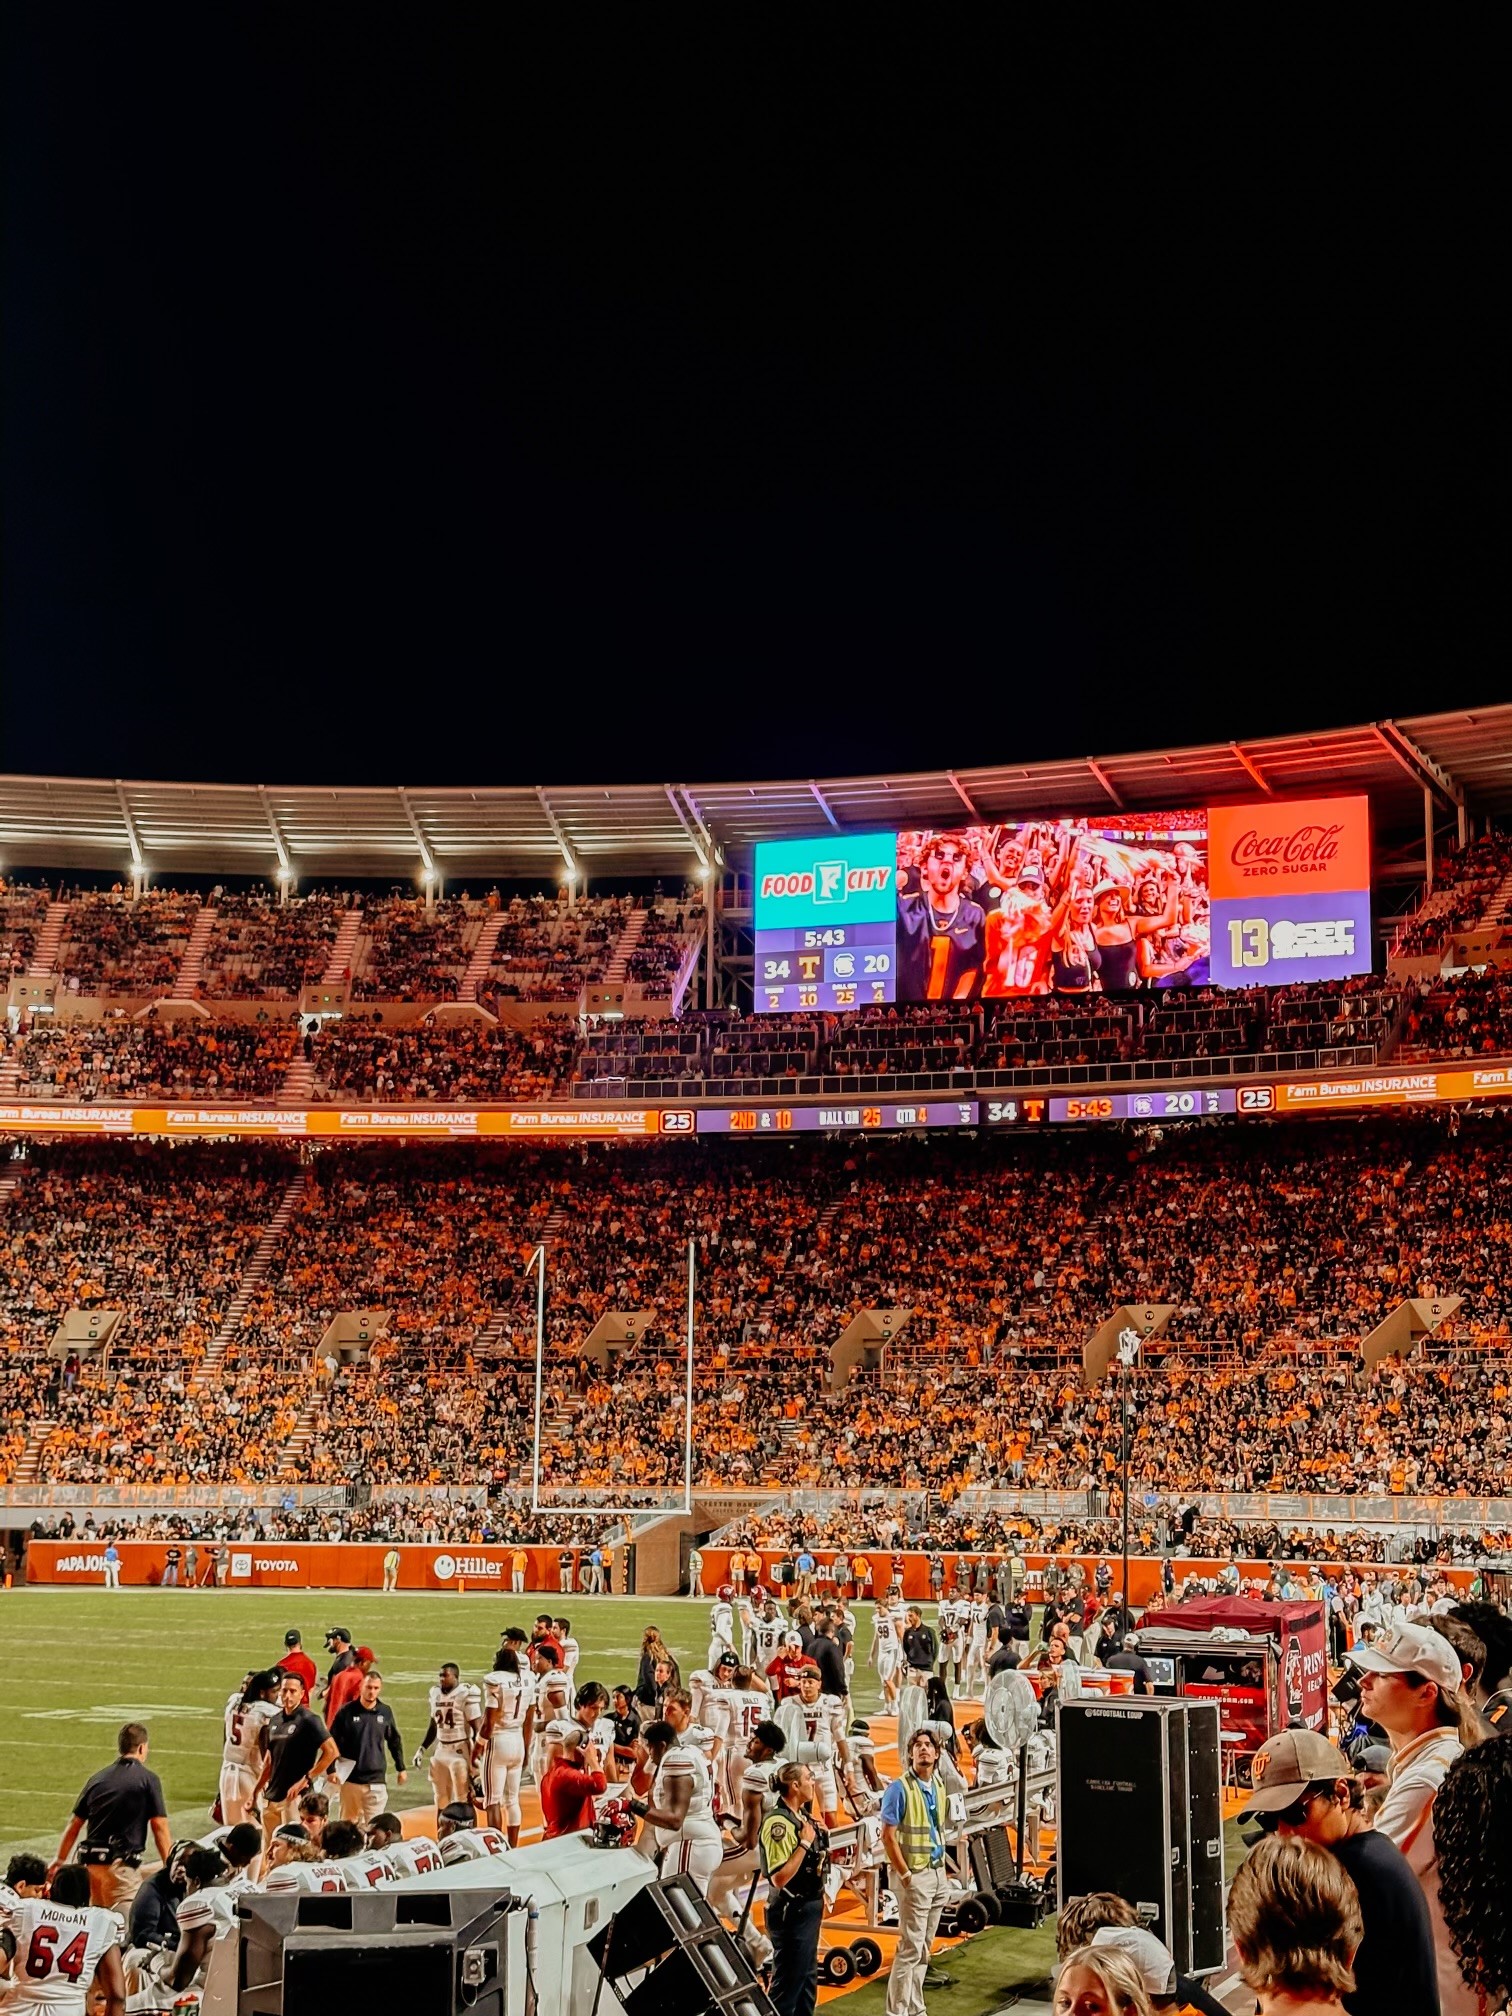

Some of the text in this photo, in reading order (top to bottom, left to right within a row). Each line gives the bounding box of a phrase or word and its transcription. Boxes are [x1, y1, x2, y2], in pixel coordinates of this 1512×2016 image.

[1231, 824, 1345, 866] Coca-Cola
[1243, 863, 1327, 877] ZERO SUGAR
[762, 867, 892, 897] FOOD CITY
[804, 929, 845, 948] 5:43
[1227, 919, 1269, 967] 13
[764, 960, 791, 979] 34
[798, 956, 820, 979] T
[864, 954, 890, 973] 20
[769, 995, 779, 1008] 2
[799, 993, 818, 1006] 10
[836, 991, 855, 1005] 25
[873, 990, 885, 1003] 4
[1288, 1075, 1436, 1097] Farm Bureau INSURANCE
[1474, 1070, 1504, 1085] Farm
[1066, 1098, 1112, 1118] 5:43
[1165, 1093, 1195, 1113] 20
[1208, 1099, 1219, 1112] 2
[1243, 1090, 1271, 1108] 25
[21, 1107, 60, 1121] Bureau
[62, 1109, 133, 1122] INSURANCE
[167, 1111, 307, 1124] Farm Bureau INSURANCE
[340, 1113, 478, 1125] Farm Bureau INSURANCE
[510, 1111, 646, 1125] Farm Bureau INSURANCE
[819, 1110, 843, 1126] BALL
[863, 1107, 881, 1127] 25
[896, 1106, 928, 1124] QTR 4
[960, 1111, 971, 1123] 3
[987, 1101, 1017, 1121] 34
[1023, 1100, 1045, 1121] T
[664, 1114, 691, 1129] 25
[730, 1110, 792, 1130] 2ND & 10
[56, 1555, 123, 1571] PAPAJOH
[254, 1559, 299, 1572] TOYOTA
[455, 1556, 503, 1574] Hiller
[760, 1632, 774, 1648] 13
[514, 1690, 522, 1719] 1
[231, 1713, 244, 1746] 5
[741, 1706, 762, 1737] 15
[805, 1720, 818, 1741] 7
[25, 1924, 90, 1984] 64
